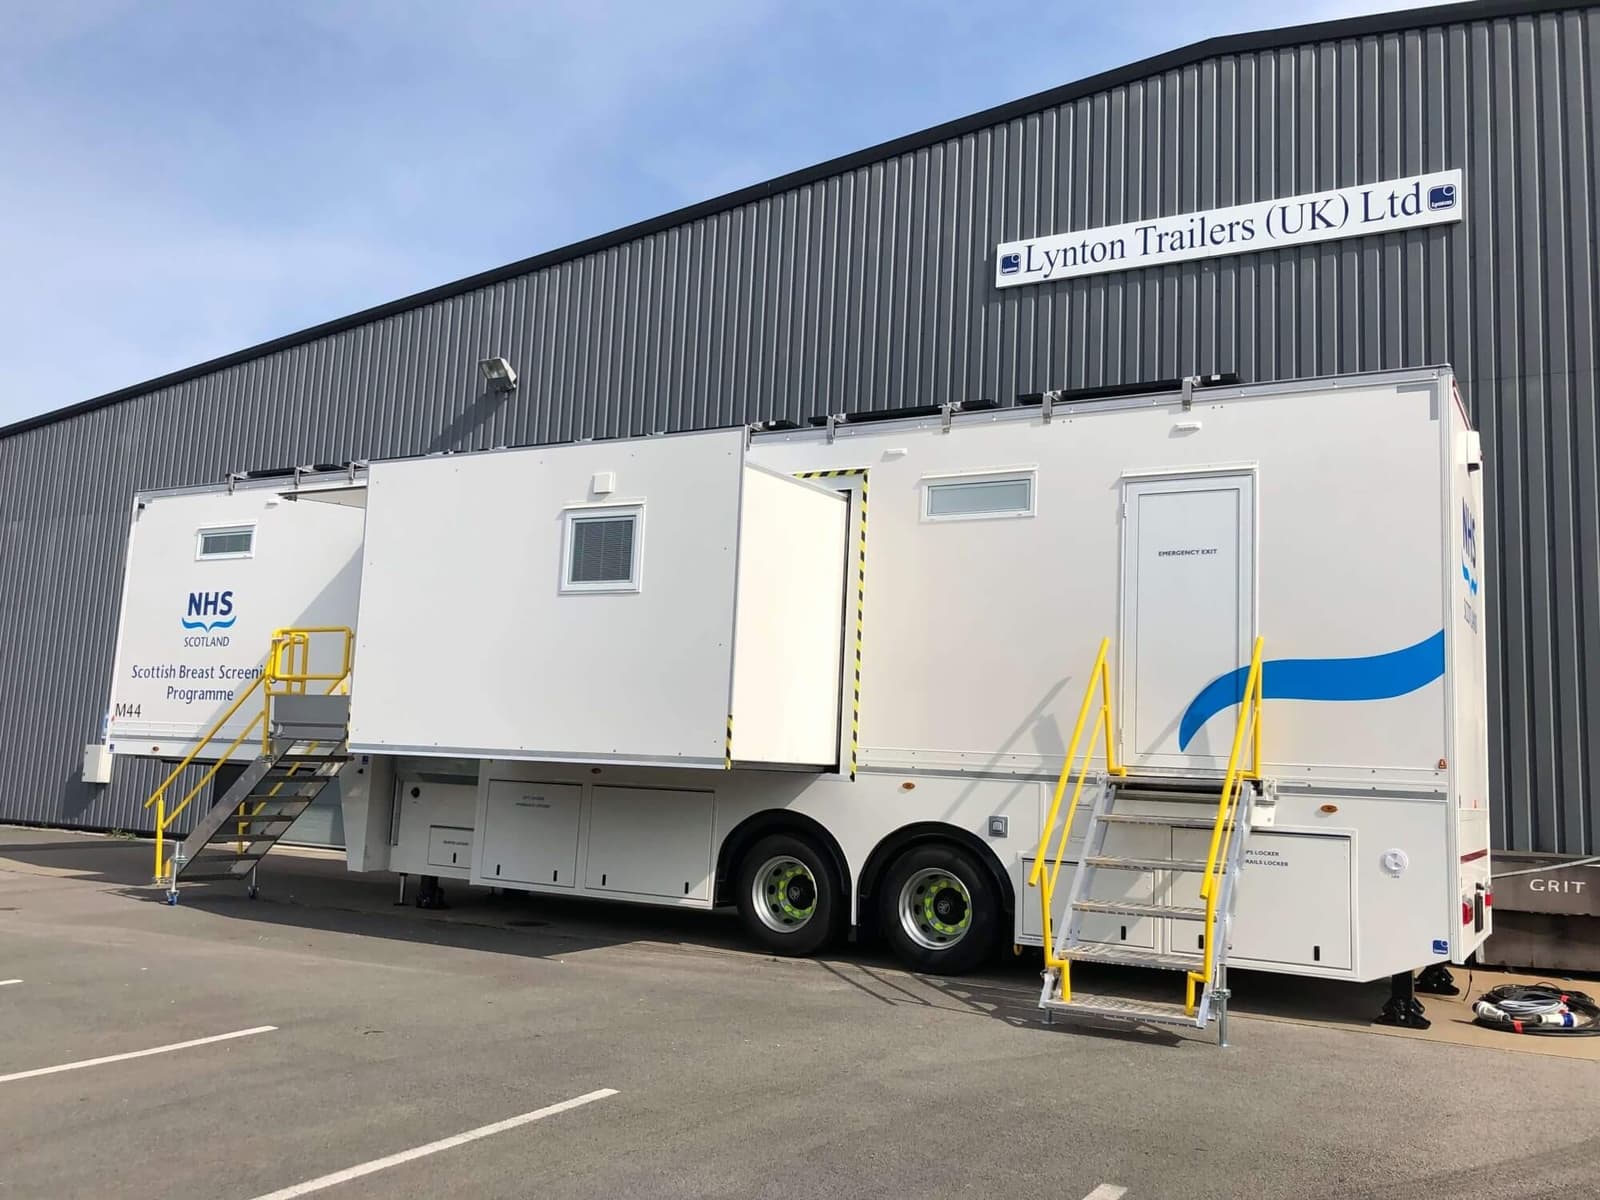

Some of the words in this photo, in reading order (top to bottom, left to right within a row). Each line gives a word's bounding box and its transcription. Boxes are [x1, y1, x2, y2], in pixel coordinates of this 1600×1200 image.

[1024, 238, 1125, 278] Lynton
[1135, 218, 1255, 256] Trailers
[1265, 194, 1350, 239] (UK)
[1361, 183, 1422, 224] Ltd
[1462, 497, 1476, 568] NHS
[1158, 549, 1200, 557] EMERGENCY
[187, 591, 233, 616] NHS
[184, 636, 230, 648] SCOTLAND
[131, 664, 176, 679] Scottish
[179, 664, 215, 680] Breast
[218, 664, 264, 680] Screeni
[166, 685, 234, 705] Programme
[115, 703, 142, 718] M44
[1529, 878, 1586, 894] GRIT
